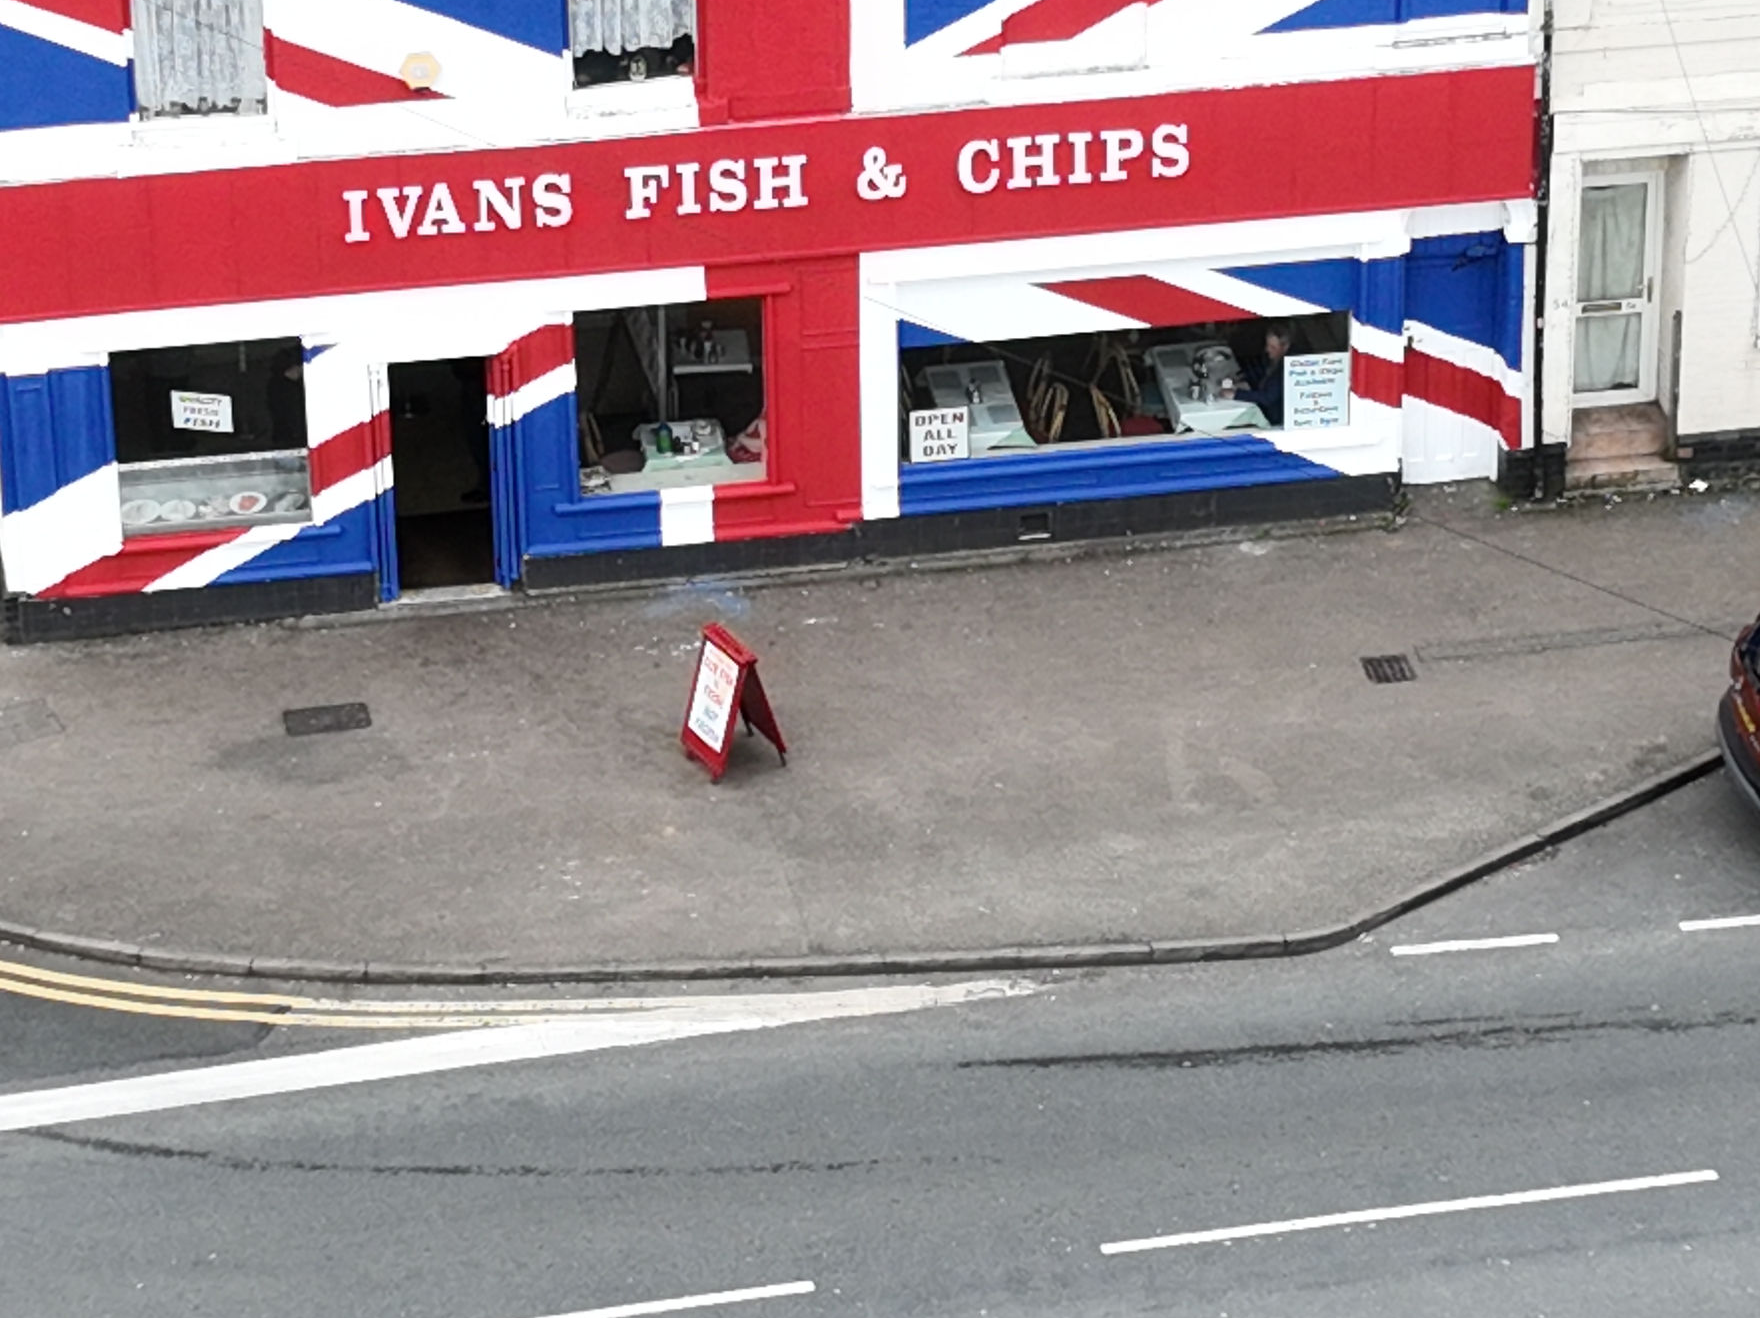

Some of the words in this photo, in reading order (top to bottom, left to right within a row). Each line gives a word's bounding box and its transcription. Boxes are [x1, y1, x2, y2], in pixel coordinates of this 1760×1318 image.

[342, 173, 573, 243] IVANS
[624, 154, 809, 220] FISH
[857, 146, 907, 200] &
[957, 123, 1190, 194] CHIPS
[914, 412, 964, 427] OPEN
[923, 428, 959, 442] ALL
[922, 443, 958, 457] DAY
